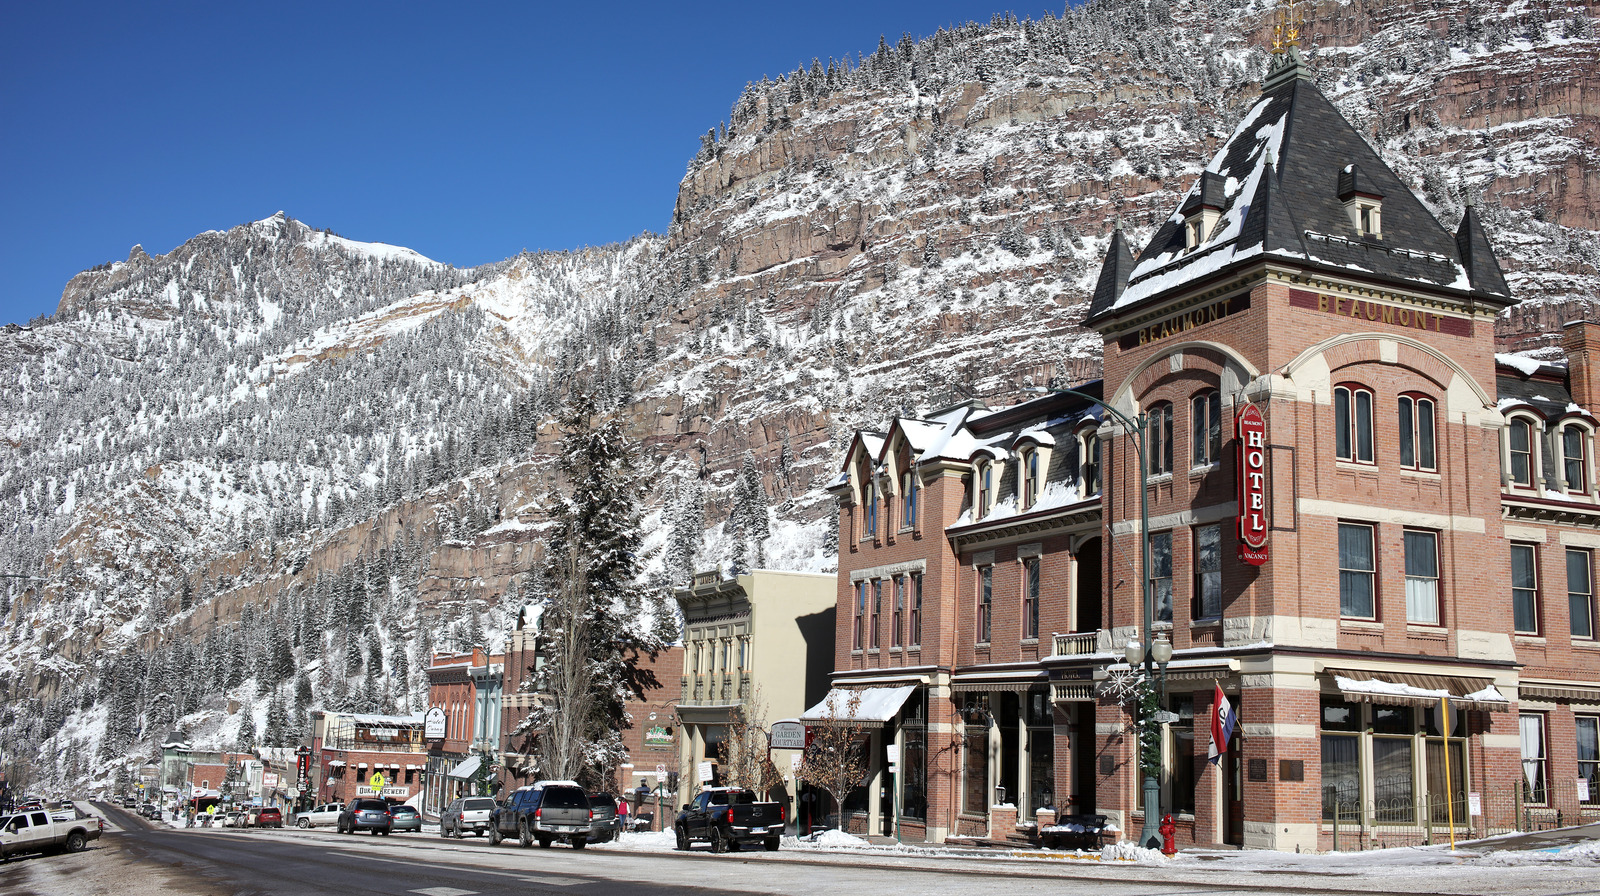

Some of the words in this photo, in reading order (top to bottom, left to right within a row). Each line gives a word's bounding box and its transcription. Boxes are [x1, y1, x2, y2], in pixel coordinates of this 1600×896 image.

[1138, 299, 1231, 346] BEAUMONT
[1318, 293, 1444, 333] BEAUMONT
[1247, 430, 1264, 532] HOTEL
[1244, 552, 1268, 560] VACANCY
